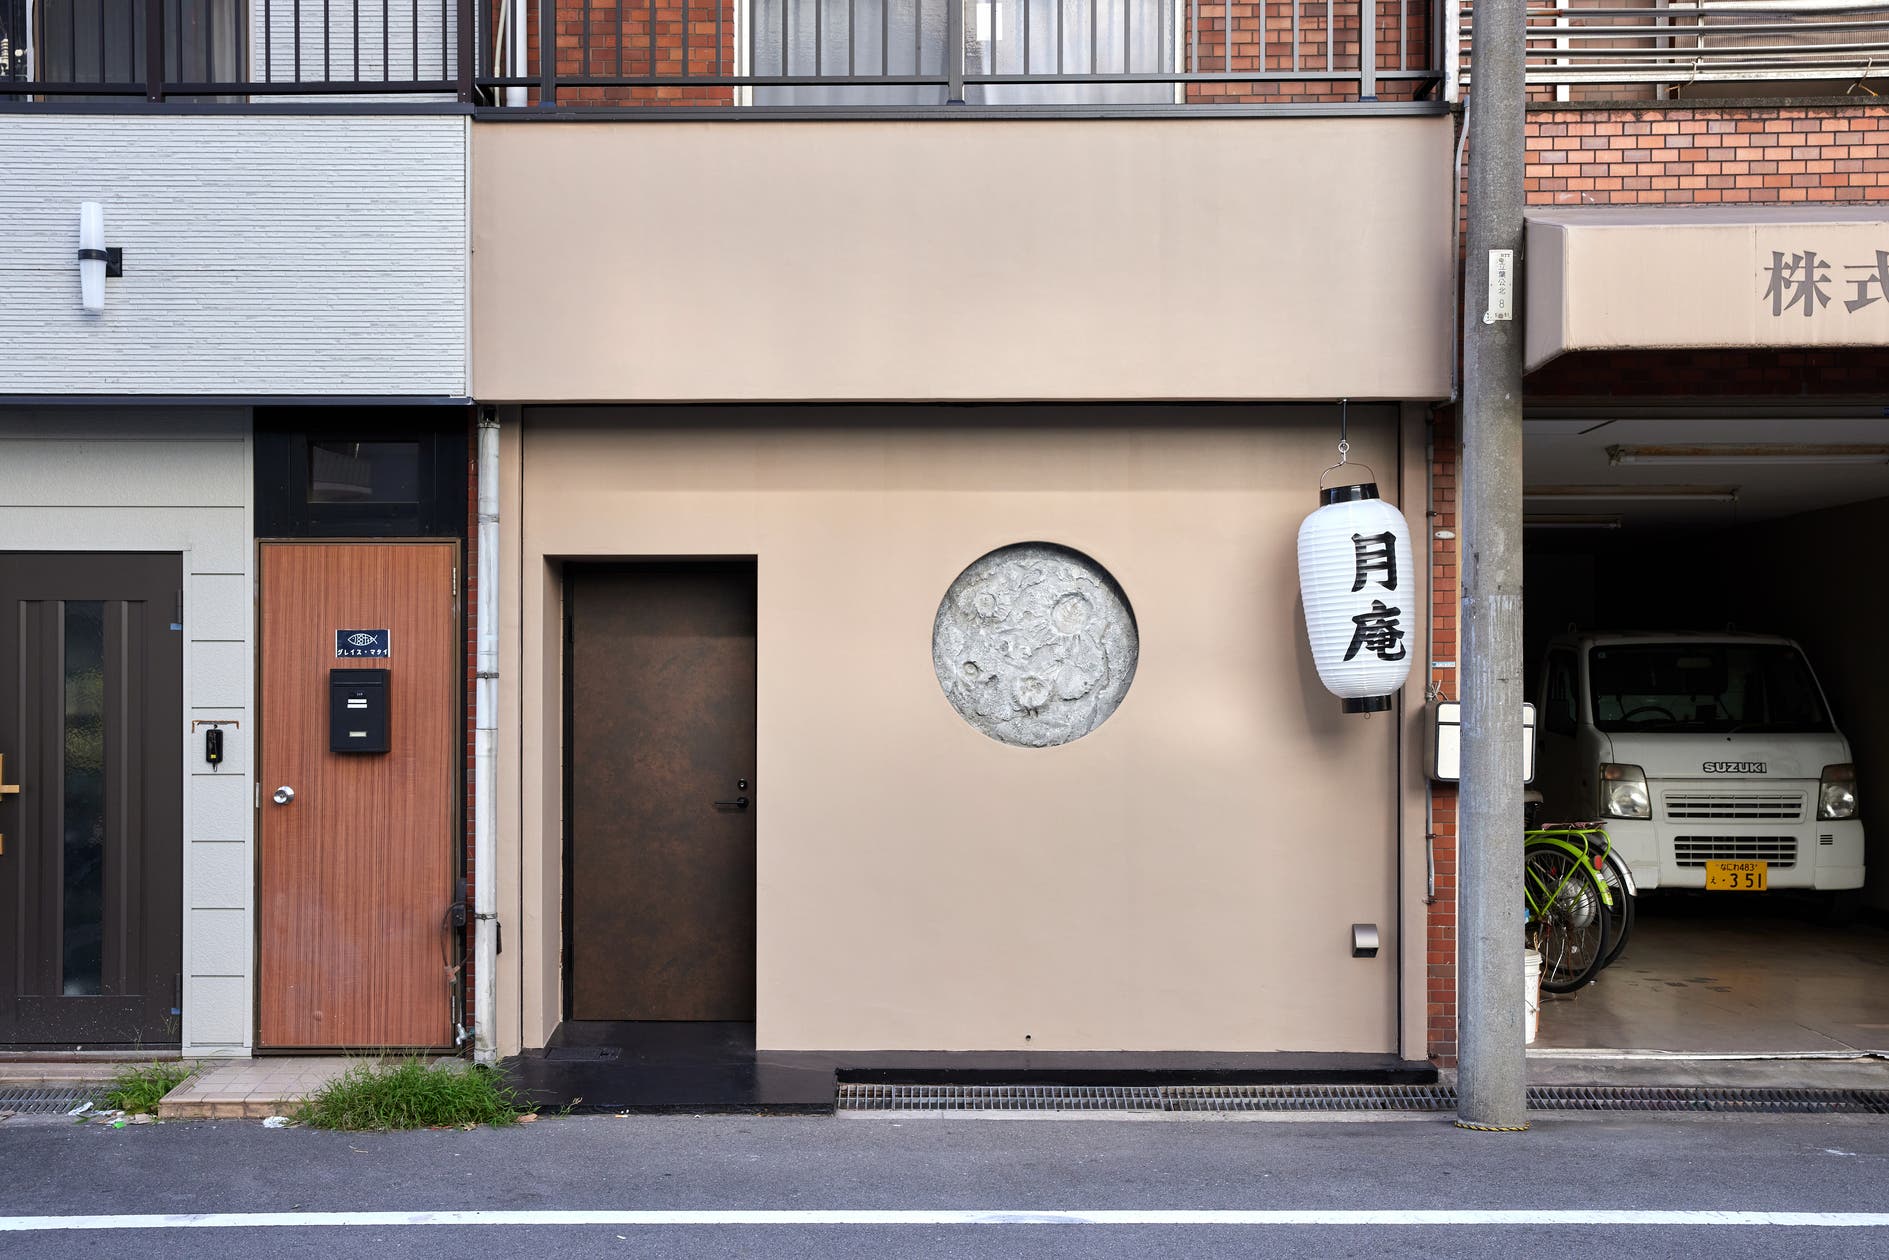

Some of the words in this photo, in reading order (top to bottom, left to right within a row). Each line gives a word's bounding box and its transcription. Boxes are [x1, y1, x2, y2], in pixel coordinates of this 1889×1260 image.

[1763, 250, 1889, 317] 株式
[1343, 531, 1407, 662] 月庵
[1703, 761, 1767, 774] SUZUKI
